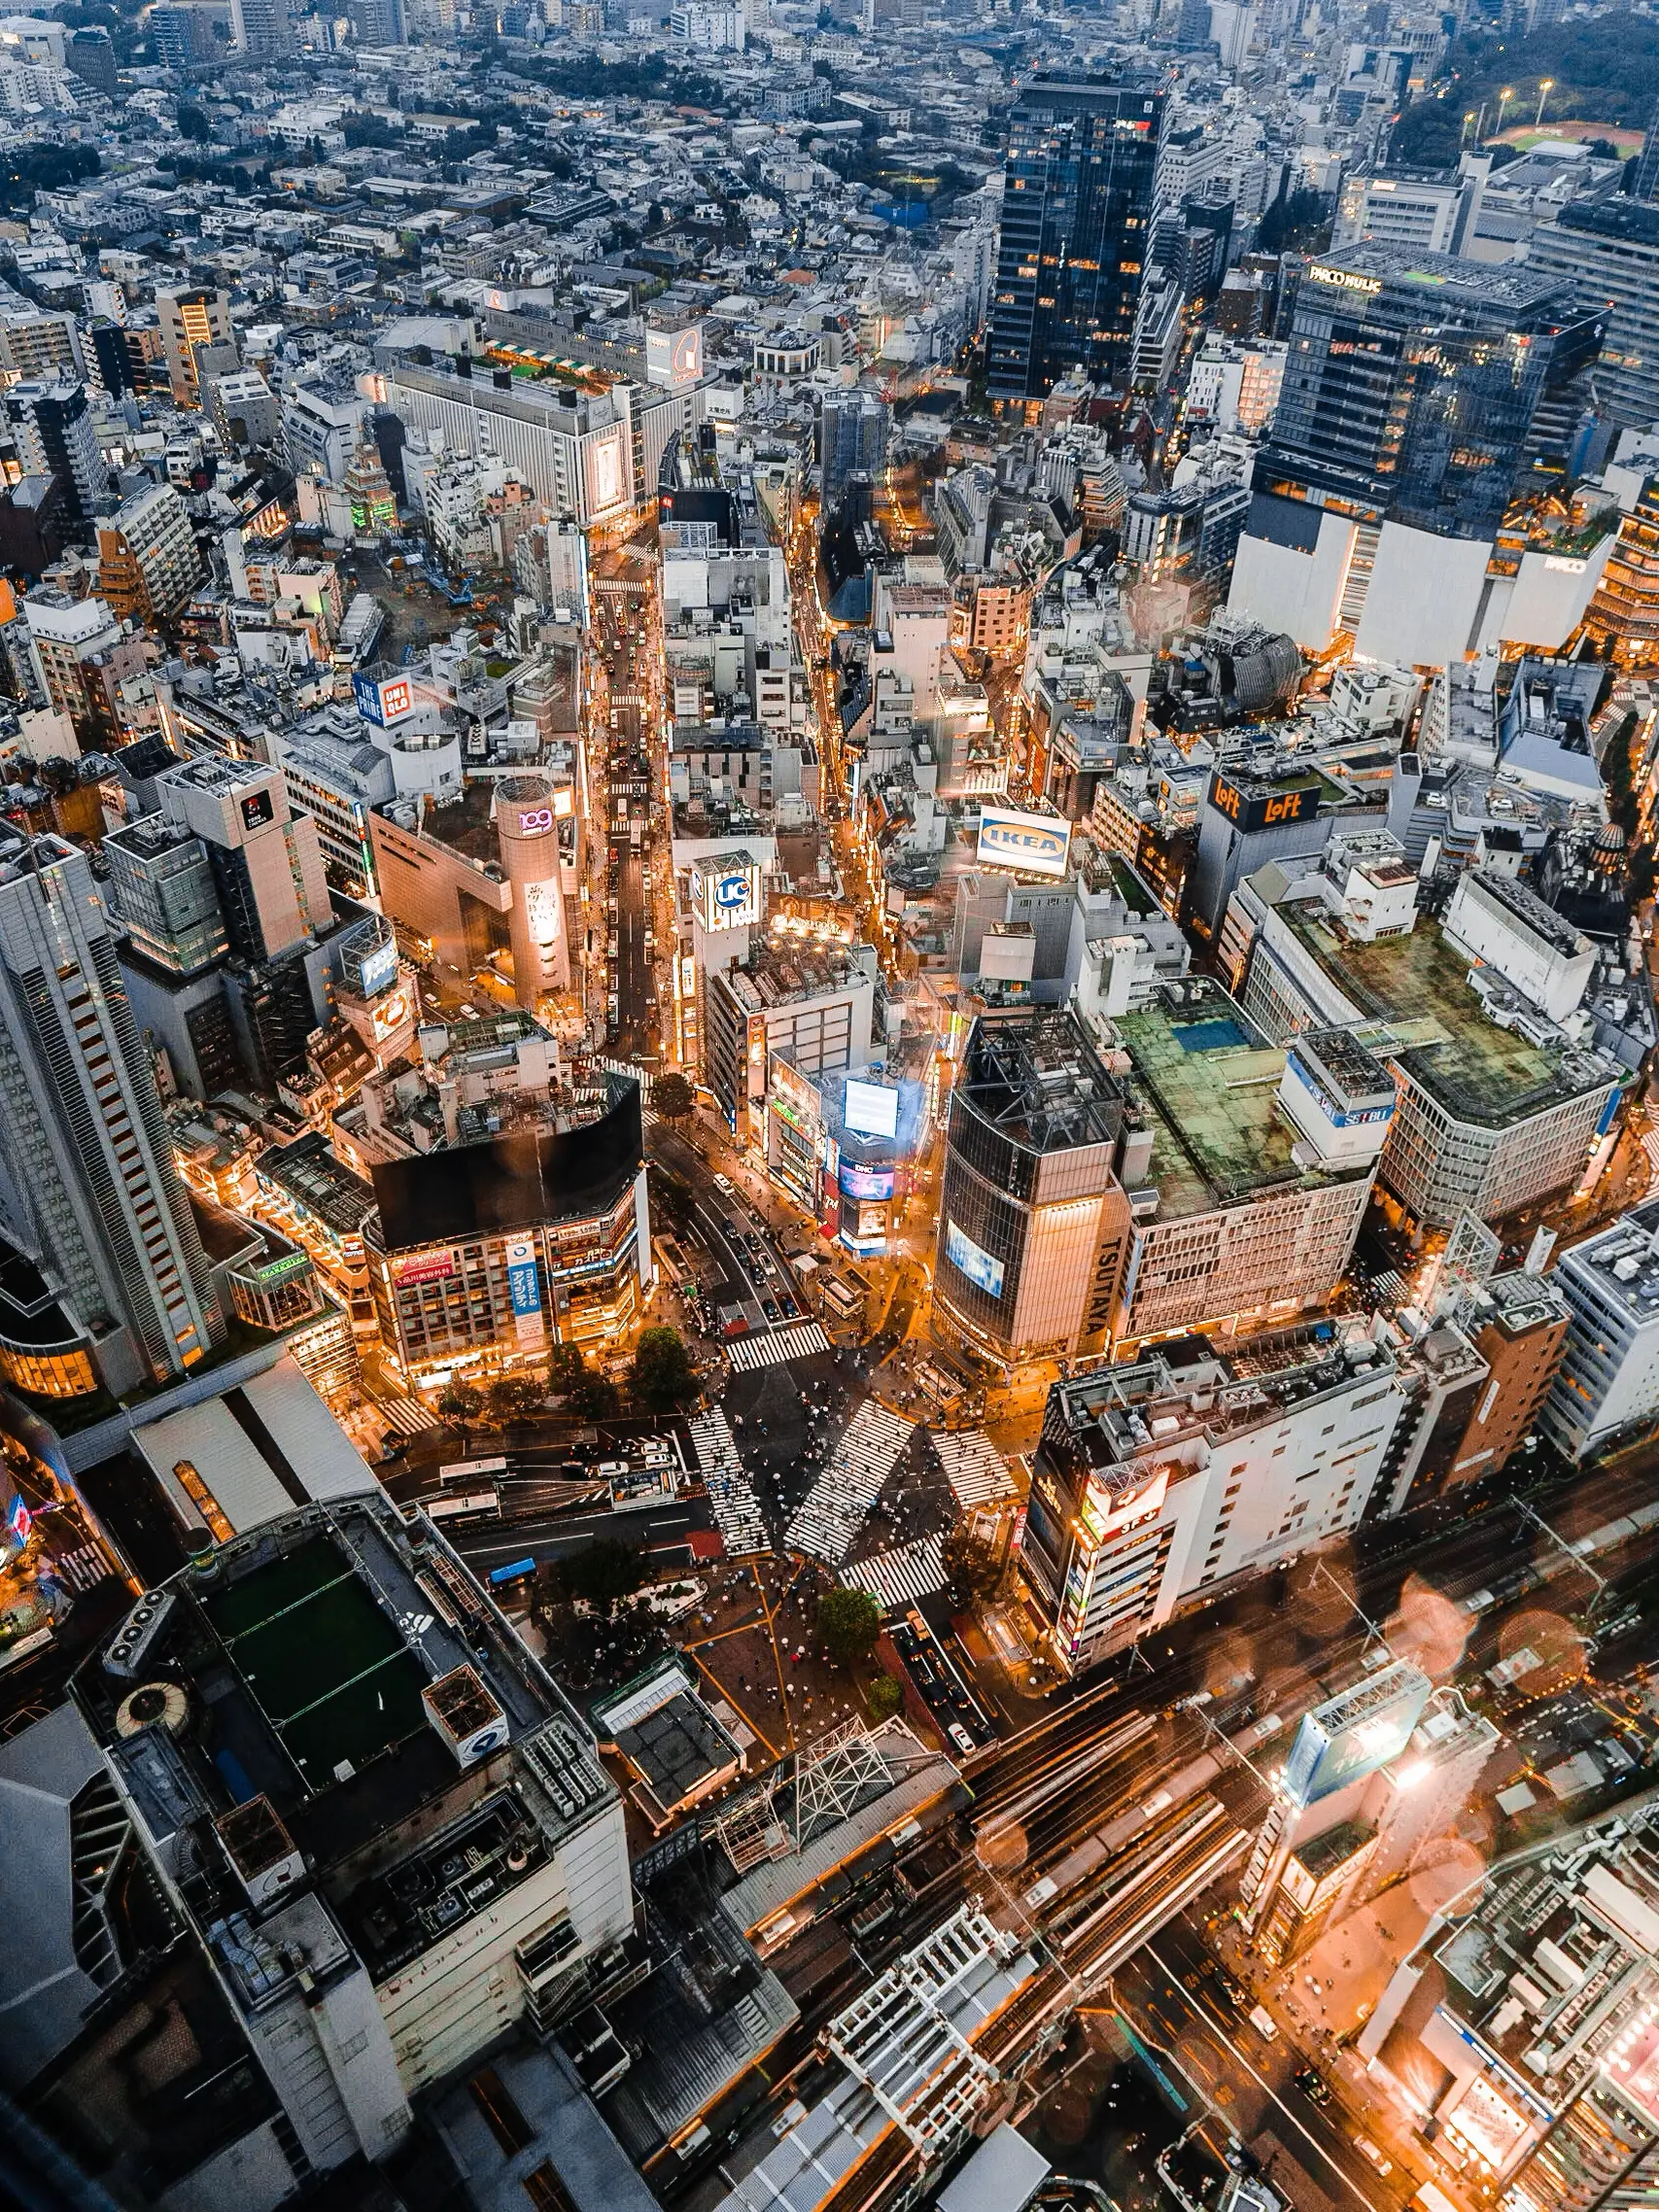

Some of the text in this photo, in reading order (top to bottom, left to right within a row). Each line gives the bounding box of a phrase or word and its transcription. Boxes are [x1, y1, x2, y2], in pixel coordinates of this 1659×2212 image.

[1310, 265, 1345, 286] PARCO
[360, 681, 375, 703] THE
[385, 685, 405, 703] UNI
[358, 696, 382, 720] PRIME
[387, 697, 408, 715] QLO
[247, 813, 261, 824] TOHO
[520, 809, 552, 833] 109
[990, 829, 1059, 852] IKEA
[1345, 1110, 1387, 1125] SEIBU
[854, 1163, 874, 1174] DHC
[1085, 1236, 1122, 1336] TSUTAYA
[1121, 1517, 1142, 1535] 3F
